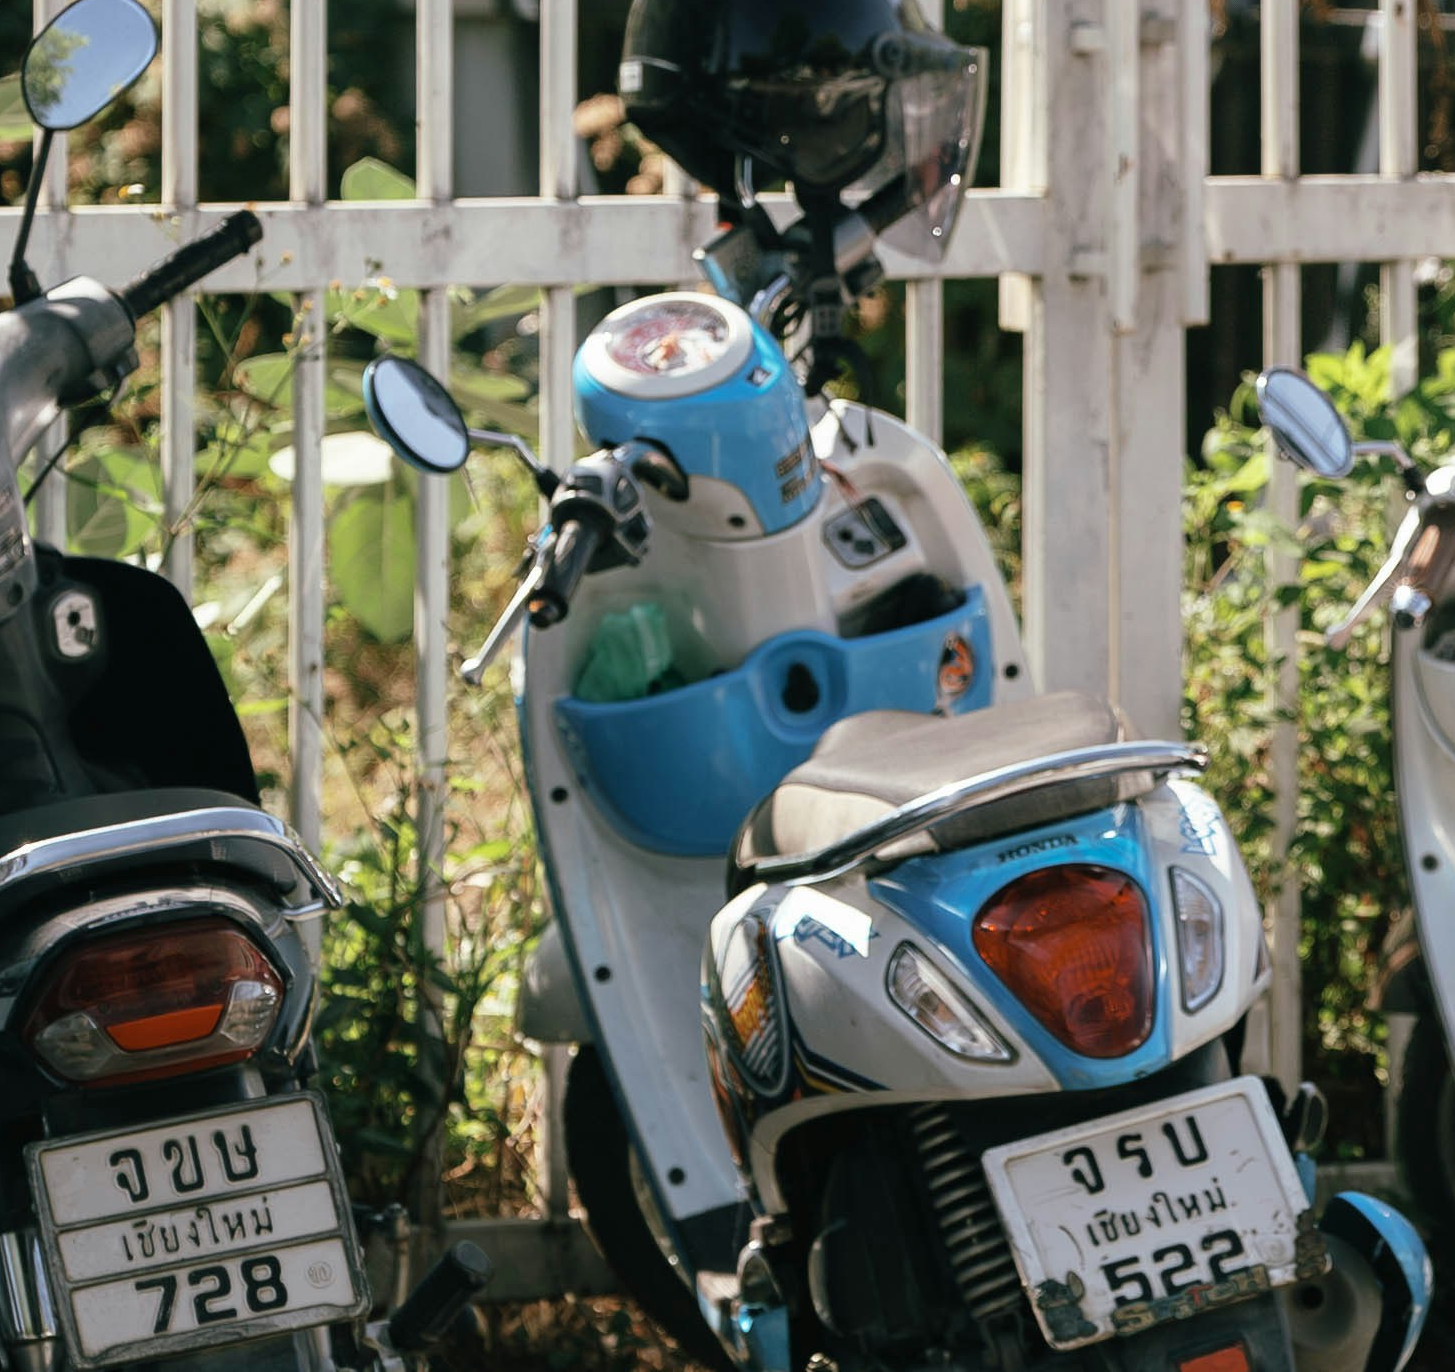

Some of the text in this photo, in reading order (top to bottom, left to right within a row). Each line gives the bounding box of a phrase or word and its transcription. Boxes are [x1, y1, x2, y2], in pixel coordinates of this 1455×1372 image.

[997, 832, 1079, 864] HONDA
[109, 1124, 259, 1204] จขษ
[1062, 1115, 1209, 1195] จรบ
[122, 1195, 274, 1261] เชียงใหม่
[1086, 1176, 1227, 1247] เชียงใหม่
[134, 1254, 289, 1334] 728
[1101, 1228, 1246, 1308] 522
